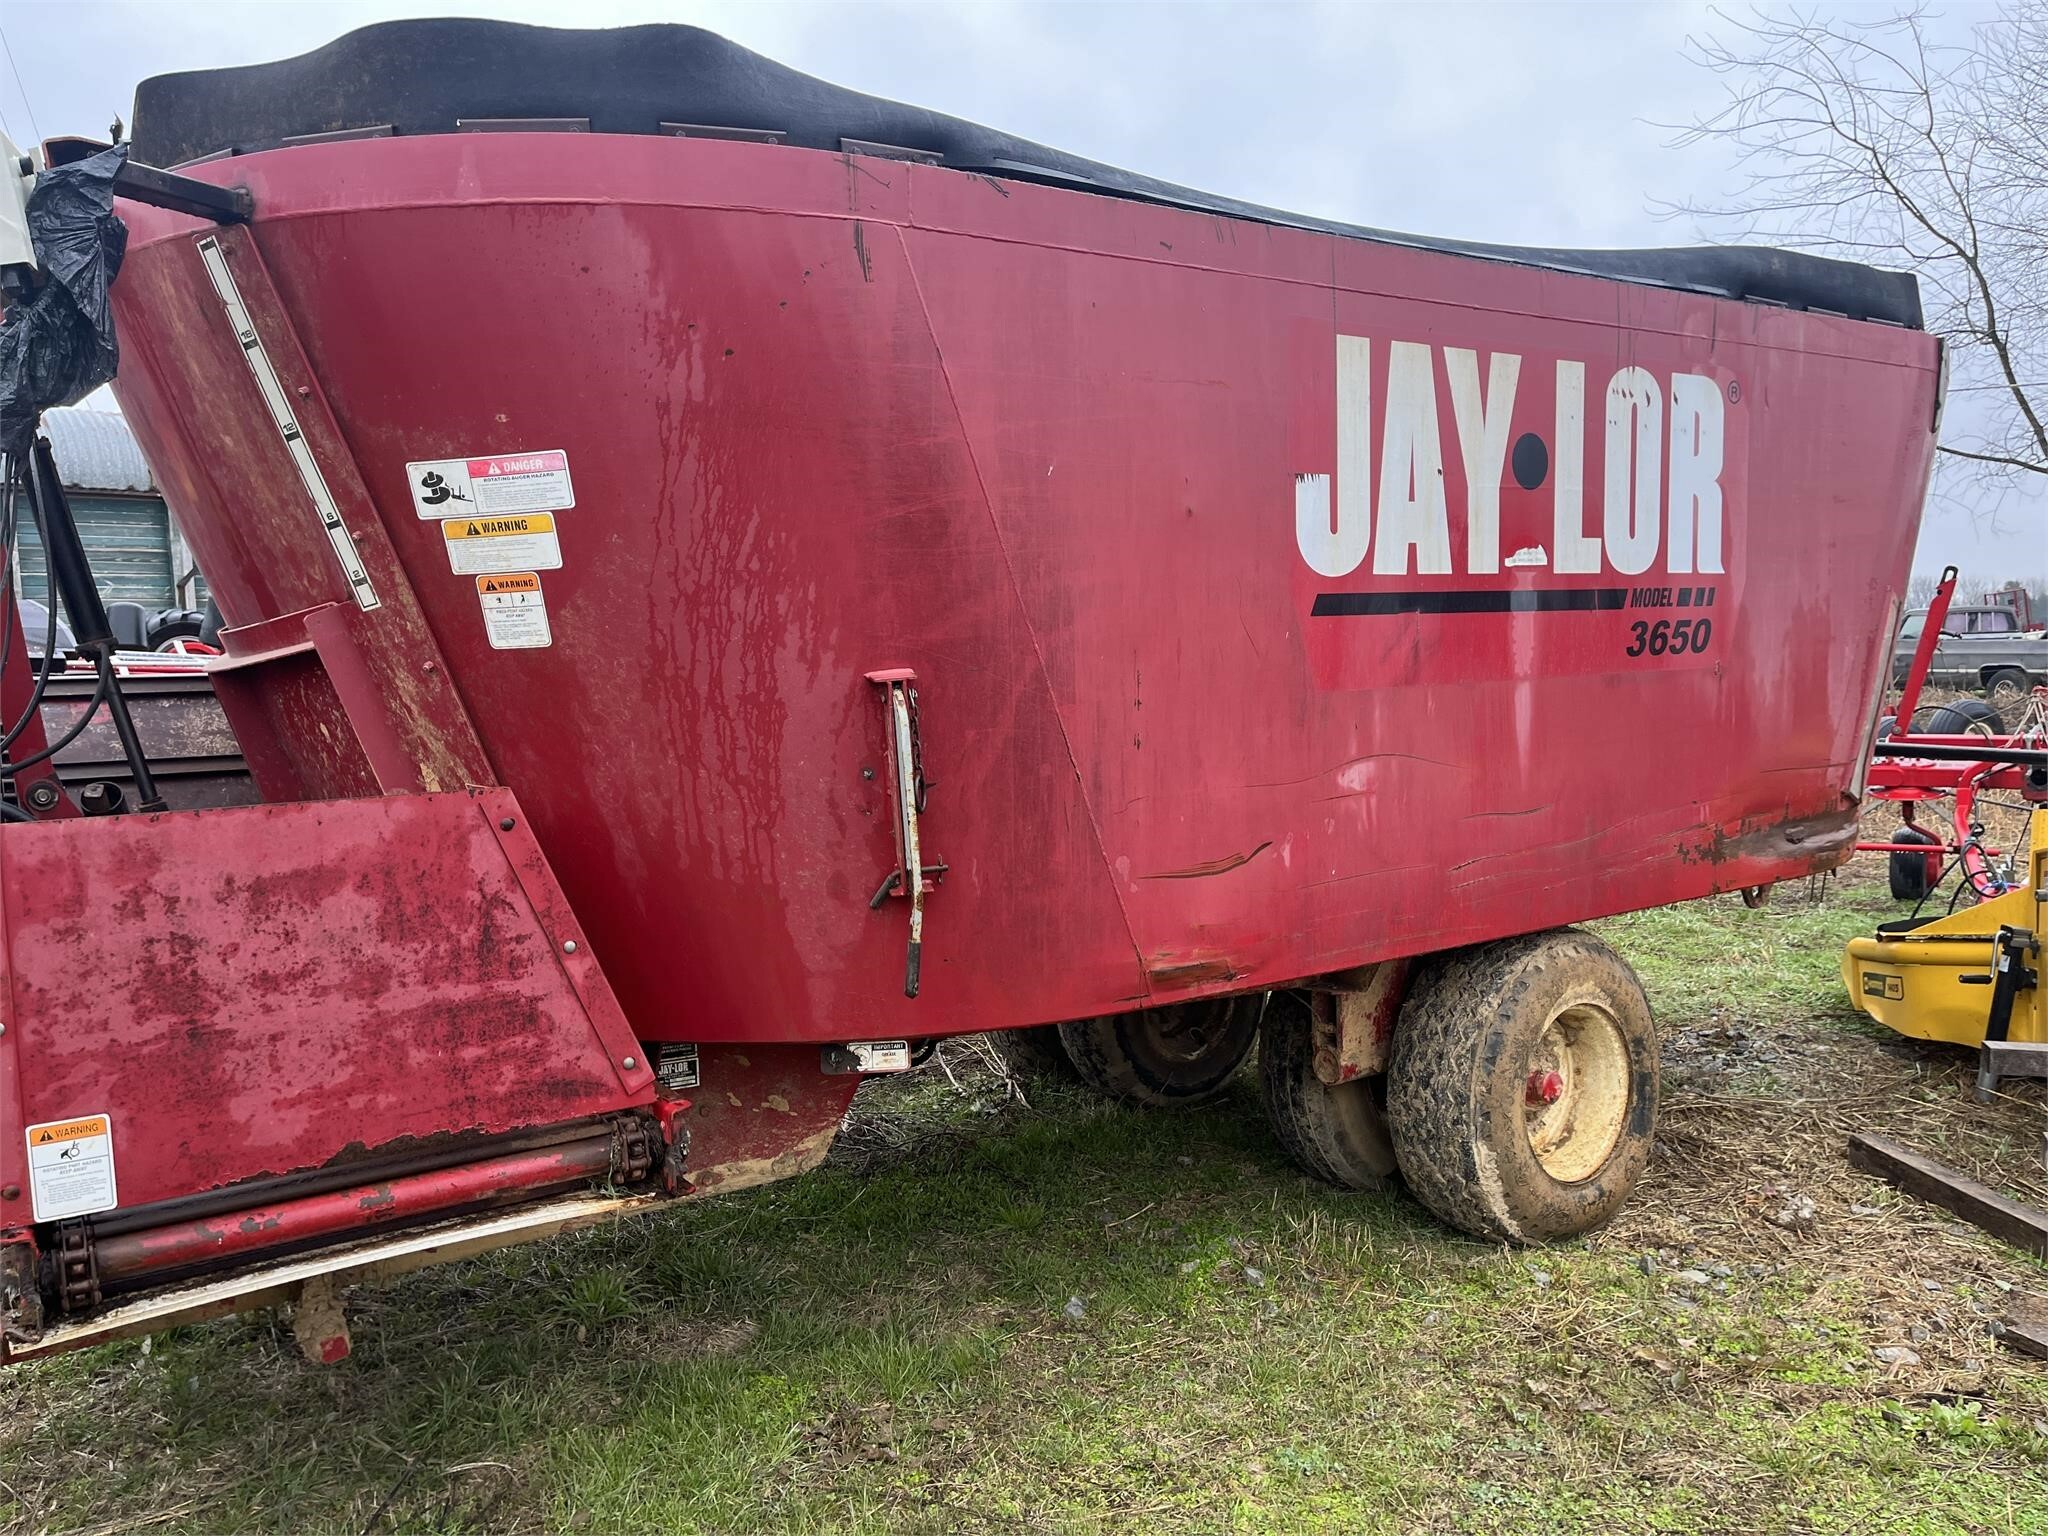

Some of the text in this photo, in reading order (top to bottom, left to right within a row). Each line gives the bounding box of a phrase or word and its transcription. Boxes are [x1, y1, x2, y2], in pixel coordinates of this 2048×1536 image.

[240, 329, 253, 340] 18
[282, 421, 296, 432] 12
[503, 459, 543, 472] DANGER
[326, 511, 335, 521] 6
[481, 519, 528, 533] WARNING
[351, 568, 361, 578] 2
[498, 579, 534, 589] WARNING
[1630, 587, 1673, 608] MODEL
[1625, 617, 1712, 657] 3650
[55, 1123, 99, 1138] WARNING
